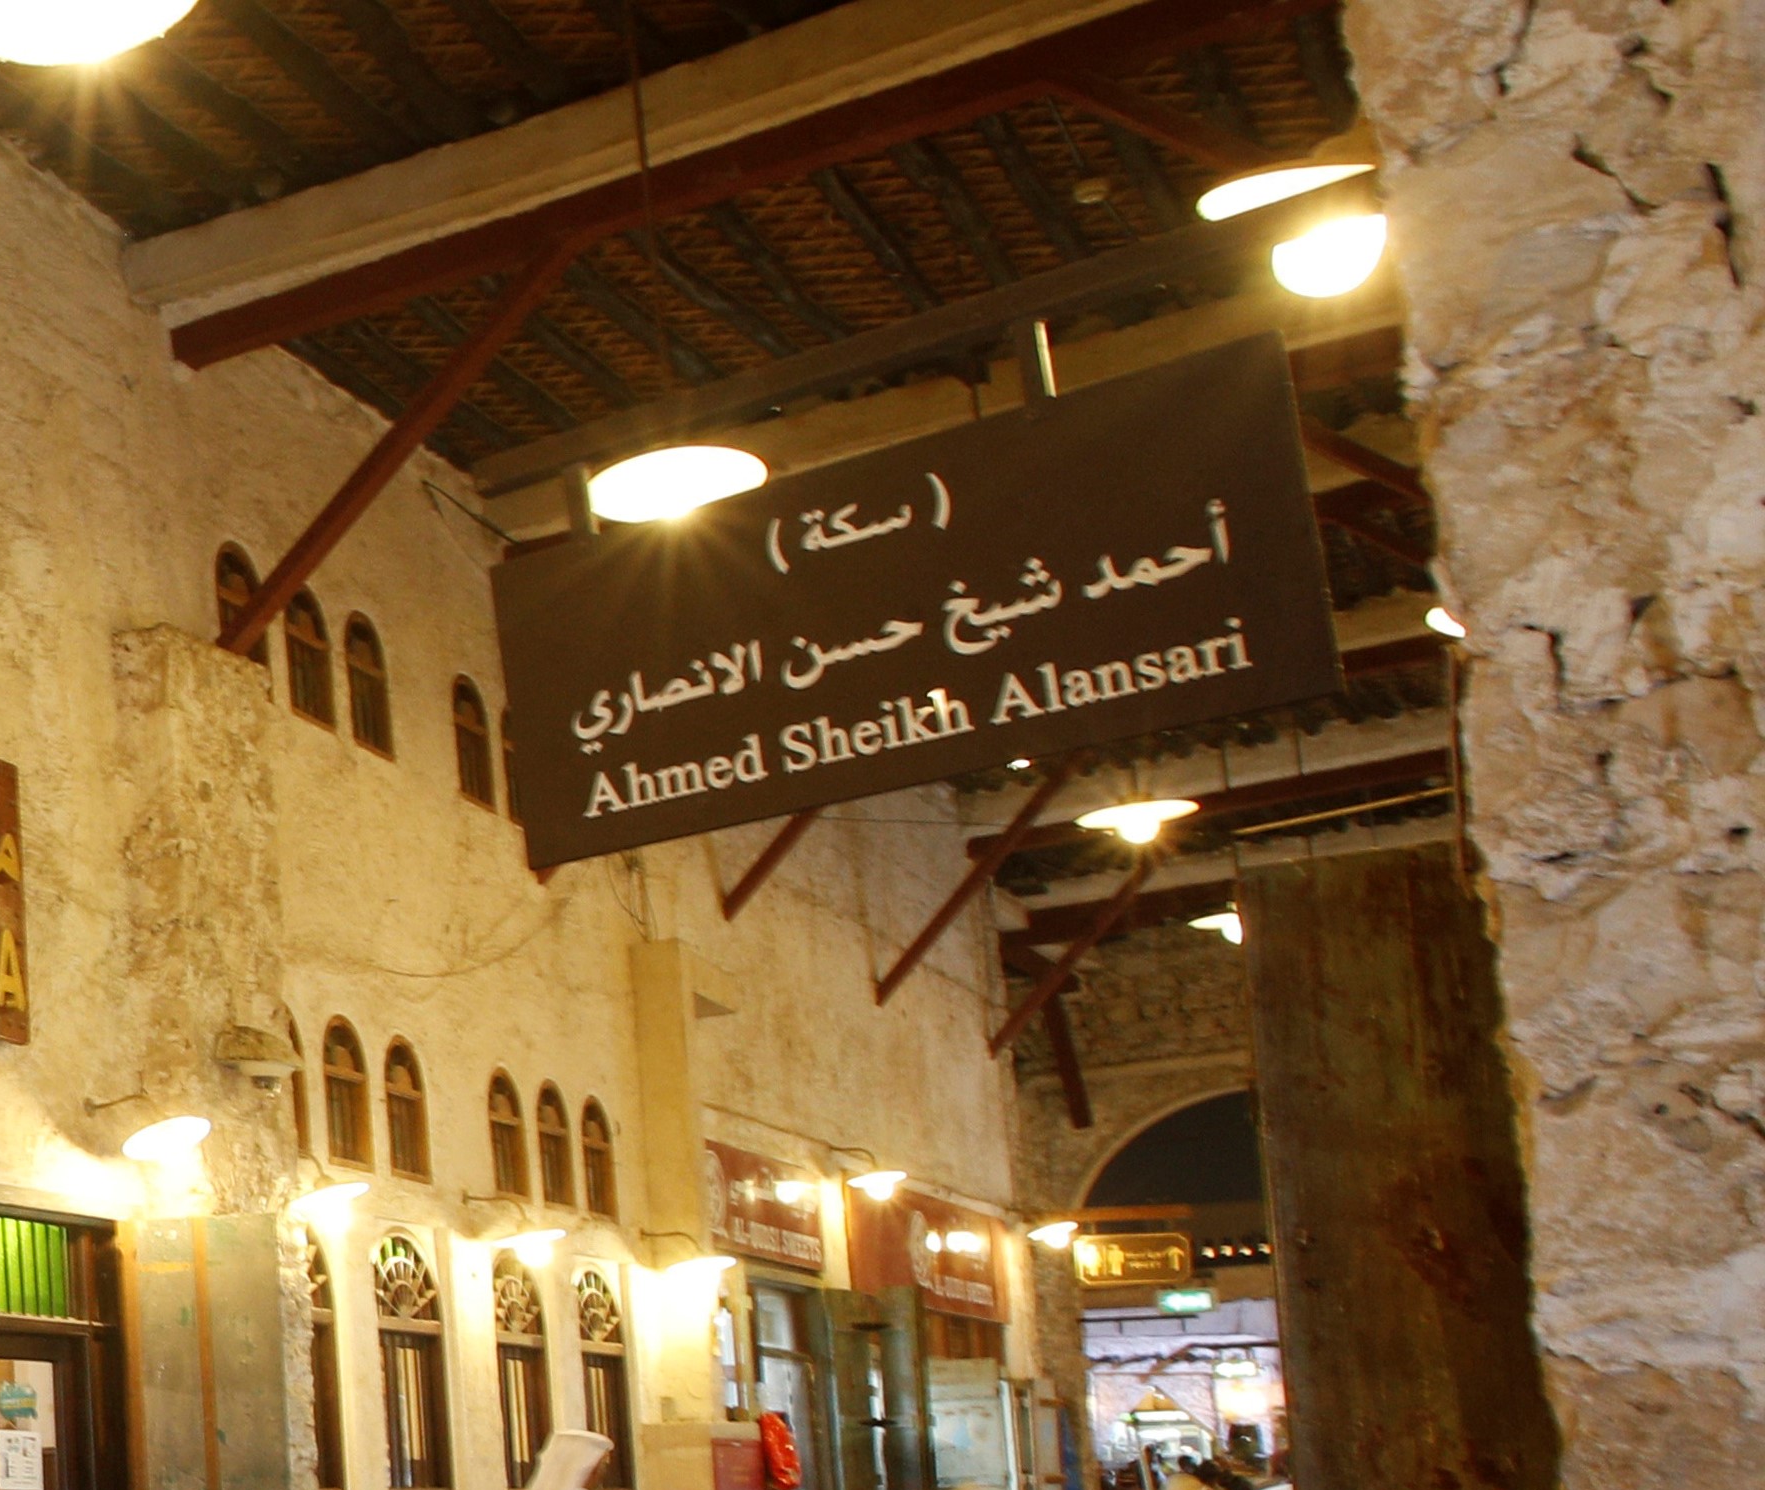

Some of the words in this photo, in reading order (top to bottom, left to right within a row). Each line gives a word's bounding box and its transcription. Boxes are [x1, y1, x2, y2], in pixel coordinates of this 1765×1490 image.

[1082, 498, 1232, 601] أحمد
[780, 613, 923, 690] حسن
[944, 558, 1063, 653] شيخ
[571, 639, 763, 753] الانصاري
[583, 734, 768, 820] Ahmed
[780, 688, 974, 774] Sheikh
[991, 616, 1253, 725] Alansari
